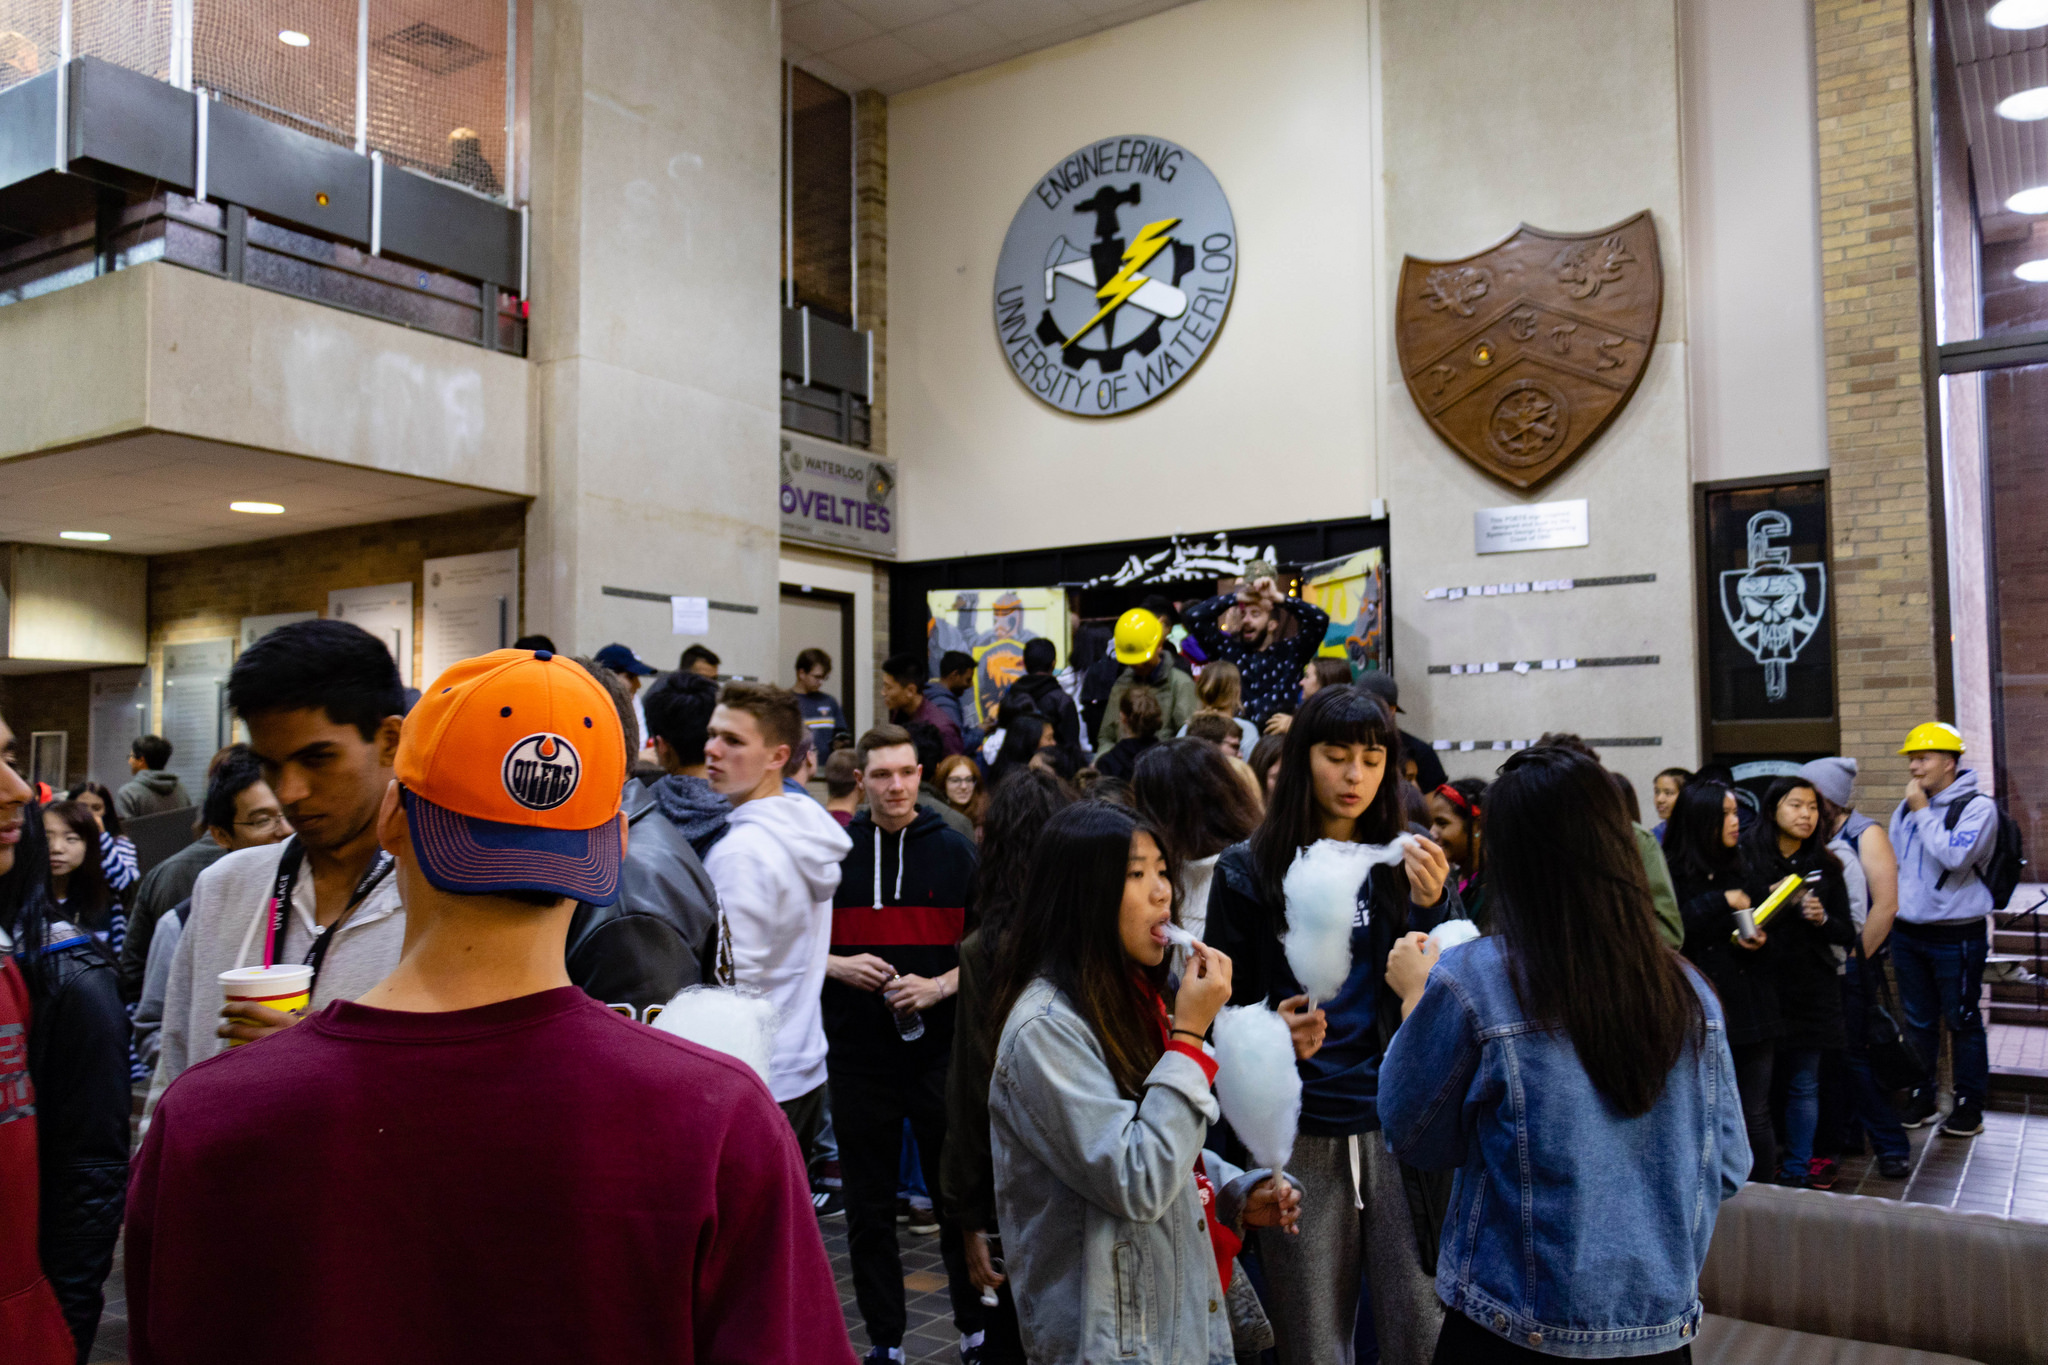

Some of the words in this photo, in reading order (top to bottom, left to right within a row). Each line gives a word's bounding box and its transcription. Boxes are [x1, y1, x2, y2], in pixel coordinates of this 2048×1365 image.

[1036, 139, 1183, 210] ENGINEERING
[997, 285, 1090, 408] UNIVERSITY
[1097, 374, 1128, 410] OF
[1135, 232, 1232, 396] WATERLOO
[804, 456, 864, 481] WATERLOO
[780, 484, 890, 534] OVELTIES
[513, 758, 573, 805] OILERS
[275, 874, 290, 909] PLACE
